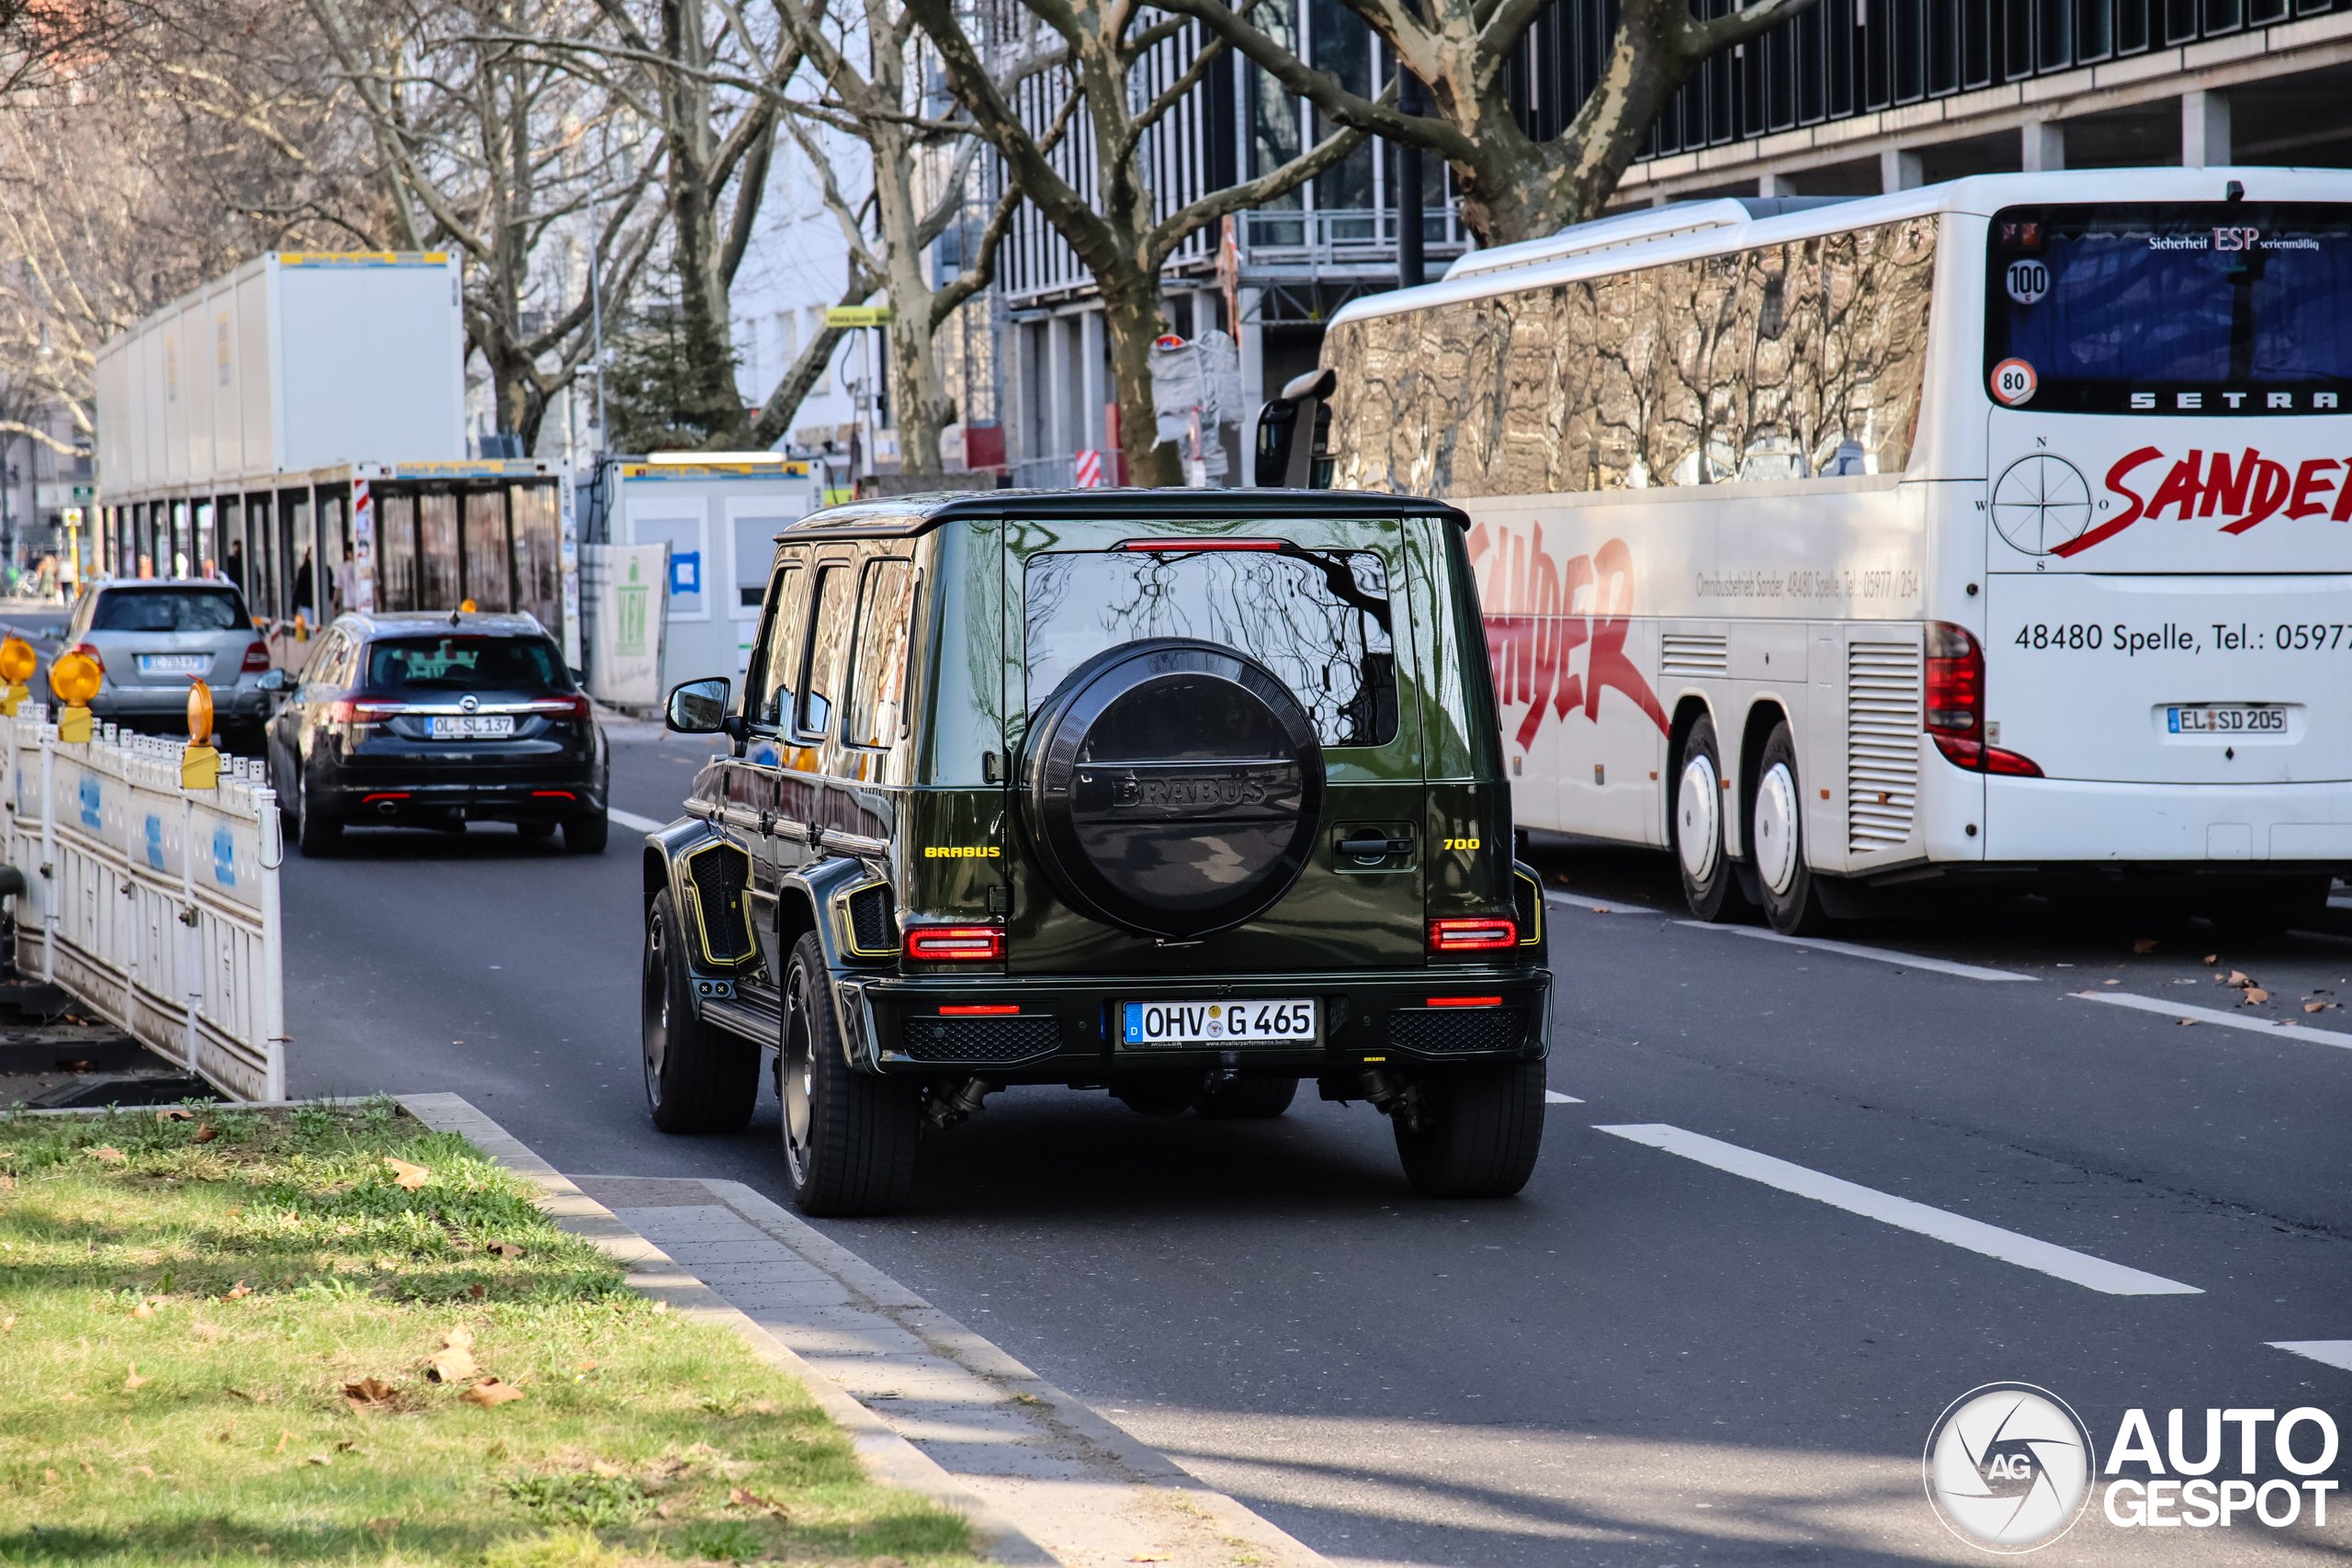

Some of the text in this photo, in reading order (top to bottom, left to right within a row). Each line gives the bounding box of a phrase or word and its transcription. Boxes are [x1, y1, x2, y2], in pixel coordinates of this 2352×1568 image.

[2149, 227, 2320, 252] Sicherheit ESP serienmäßig
[2009, 265, 2046, 294] 100
[2003, 372, 2025, 390] 80
[2131, 392, 2338, 409] SETRA
[2036, 436, 2047, 447] N
[1975, 501, 1987, 512] W
[2098, 500, 2109, 511] O
[2036, 560, 2046, 571] S
[1696, 570, 1755, 598] Omnibusbetrieb
[1757, 570, 1784, 602] Sander,
[1787, 570, 1814, 598] 48480
[1815, 570, 1842, 604] Spelle,
[1844, 570, 1861, 598] Tel.:
[1863, 570, 1892, 598] 05977
[1901, 570, 1918, 598] 254
[1467, 519, 1672, 754] ANDER
[2015, 624, 2103, 649] 48480
[2113, 623, 2201, 657] Spelle,
[2211, 623, 2265, 649] Tel.:
[435, 716, 512, 733] OL SL 137
[2180, 711, 2282, 729] EL SD 205
[1112, 777, 1268, 807] BRABUS
[924, 846, 1001, 858] BRABUS
[1443, 839, 1480, 850] 700
[1130, 1004, 1311, 1038] D OHV G 465
